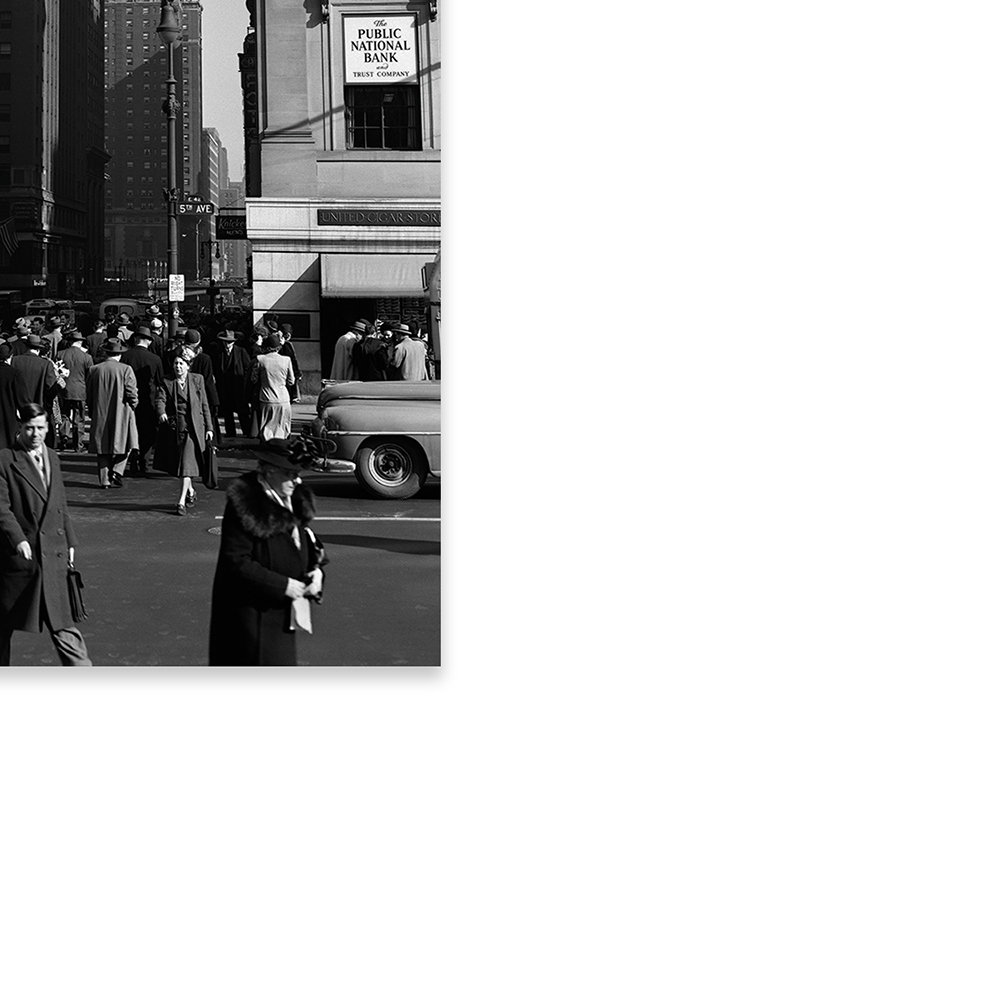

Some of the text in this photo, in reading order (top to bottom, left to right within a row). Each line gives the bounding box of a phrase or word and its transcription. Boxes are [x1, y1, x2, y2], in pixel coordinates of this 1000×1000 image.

[373, 19, 387, 27] The
[357, 28, 402, 39] PUBLIC
[350, 40, 411, 51] NATIONAL
[364, 52, 399, 63] BANK
[195, 204, 213, 214] AVE
[321, 212, 365, 222] UNITED
[367, 212, 404, 223] CIGAR
